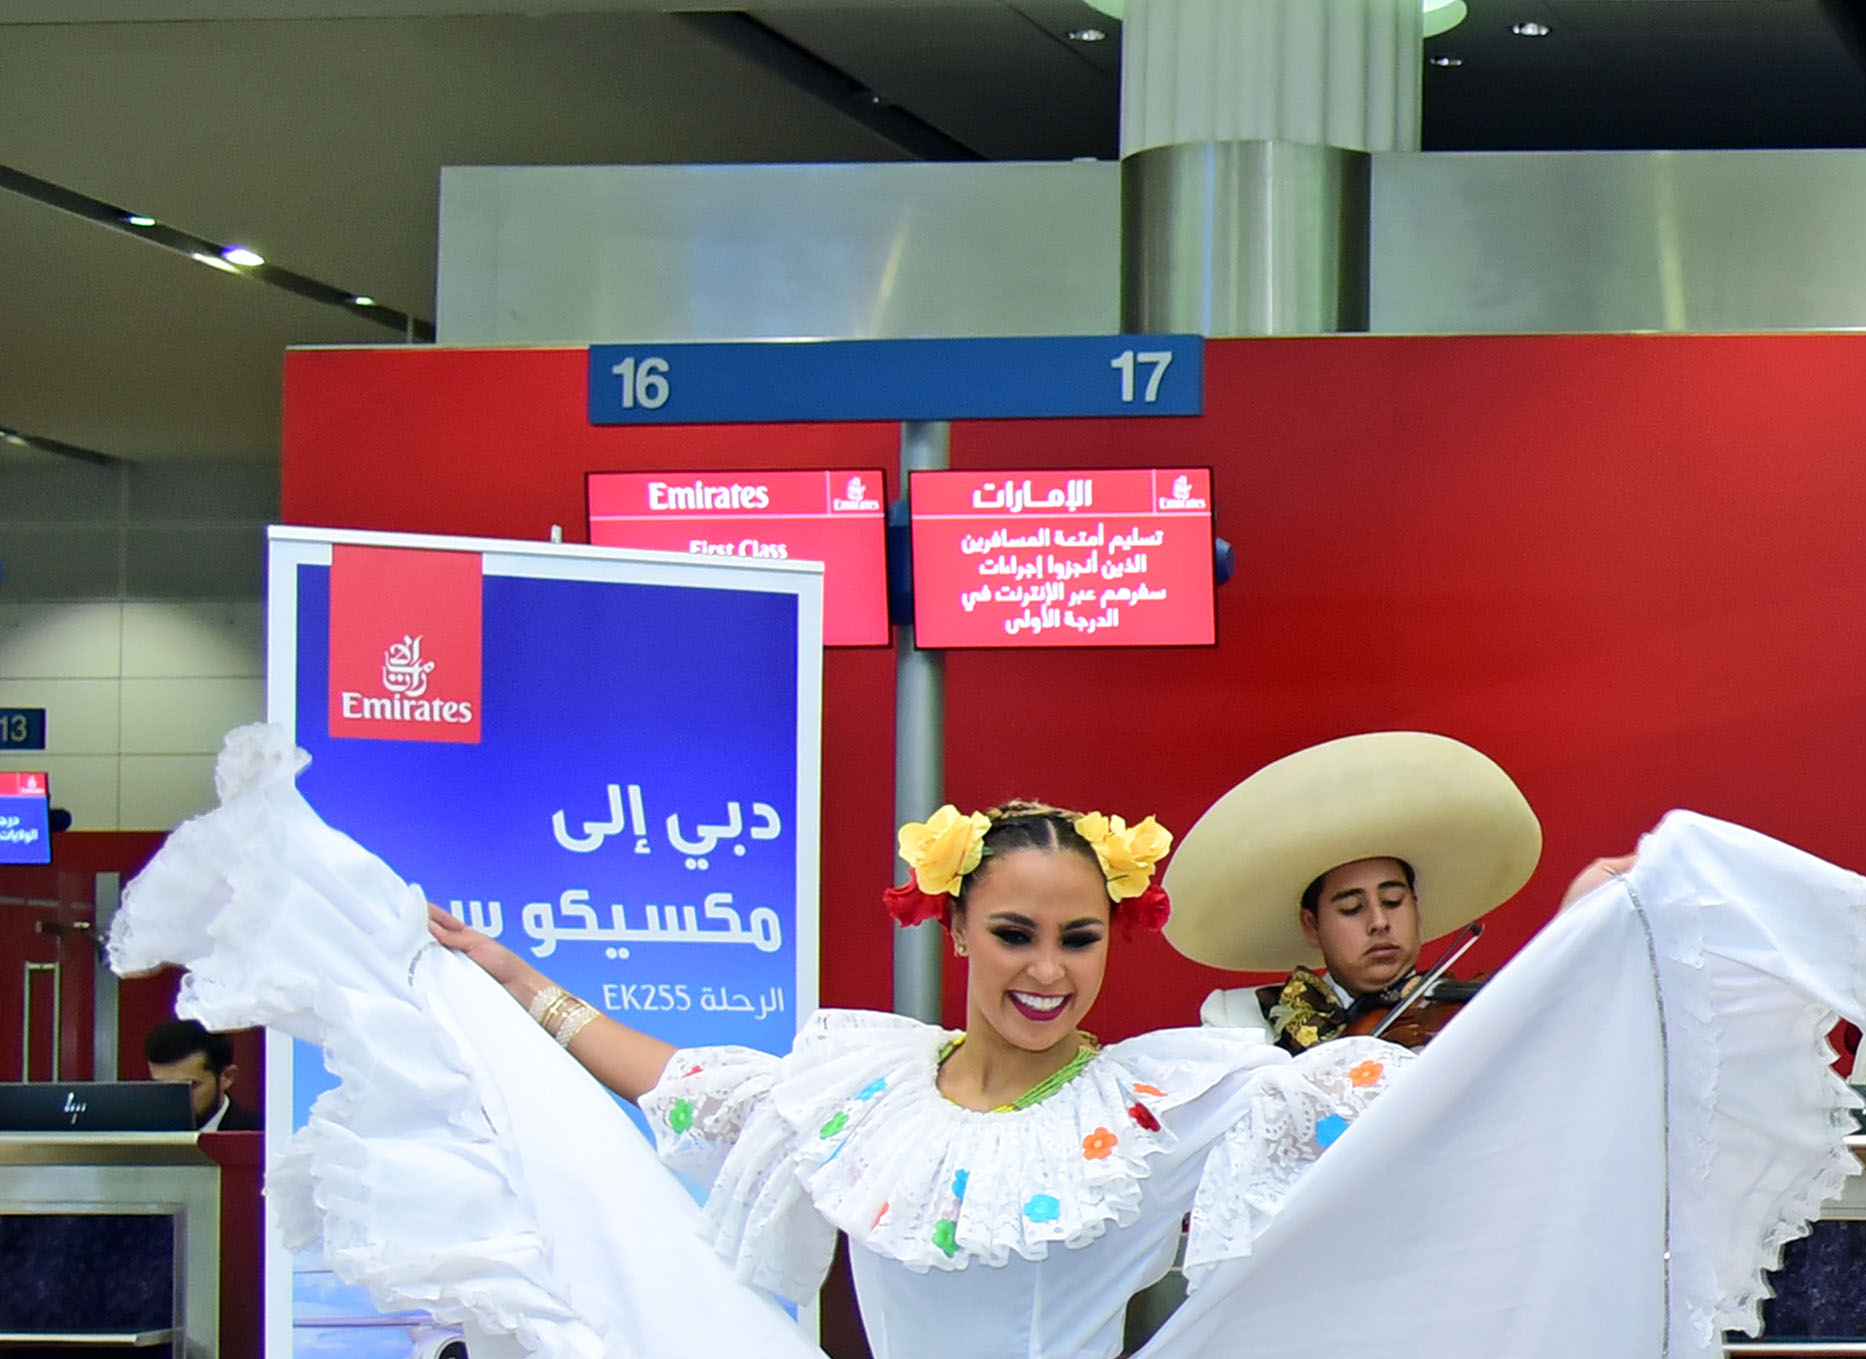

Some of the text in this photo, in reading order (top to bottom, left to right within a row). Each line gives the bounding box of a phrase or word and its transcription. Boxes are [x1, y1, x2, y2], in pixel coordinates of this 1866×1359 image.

[612, 357, 669, 409] 16
[1111, 351, 1173, 403] 17
[648, 480, 770, 510] Emirates
[972, 479, 1093, 512] الإمارات
[738, 539, 788, 560] Class
[961, 522, 1164, 554] تسليم أمتعة المسافرين
[1101, 554, 1147, 579] الذين
[962, 585, 992, 611] في
[1068, 589, 1096, 606] عبر
[1100, 583, 1167, 608] سفرهم
[1064, 608, 1119, 633] الدرجة
[342, 692, 473, 723] Emirates
[0, 716, 27, 742] 13
[552, 783, 782, 870] دبي إلى
[522, 889, 783, 960] مكسيكو
[603, 985, 784, 1021] الرحلة EK255
